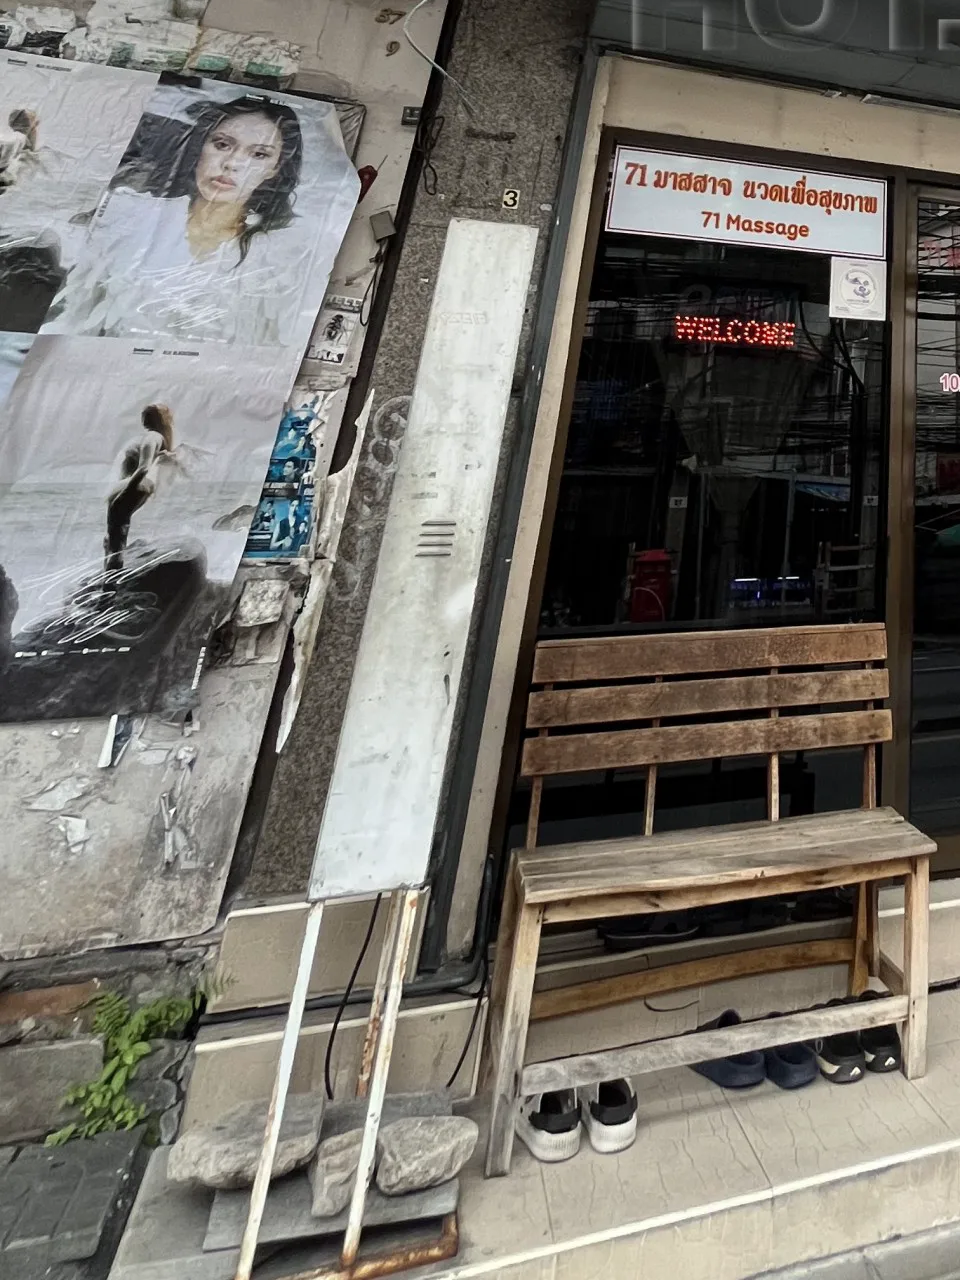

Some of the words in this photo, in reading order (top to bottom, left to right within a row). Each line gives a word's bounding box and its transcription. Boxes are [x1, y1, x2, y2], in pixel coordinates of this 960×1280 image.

[503, 190, 518, 207] 3
[625, 162, 647, 187] 71
[653, 169, 732, 197] มาสสาจ
[743, 174, 878, 216] นวดเพื่อสุขภาพ
[701, 211, 721, 230] 71
[727, 214, 810, 241] Massage
[675, 315, 796, 347] WELCOME
